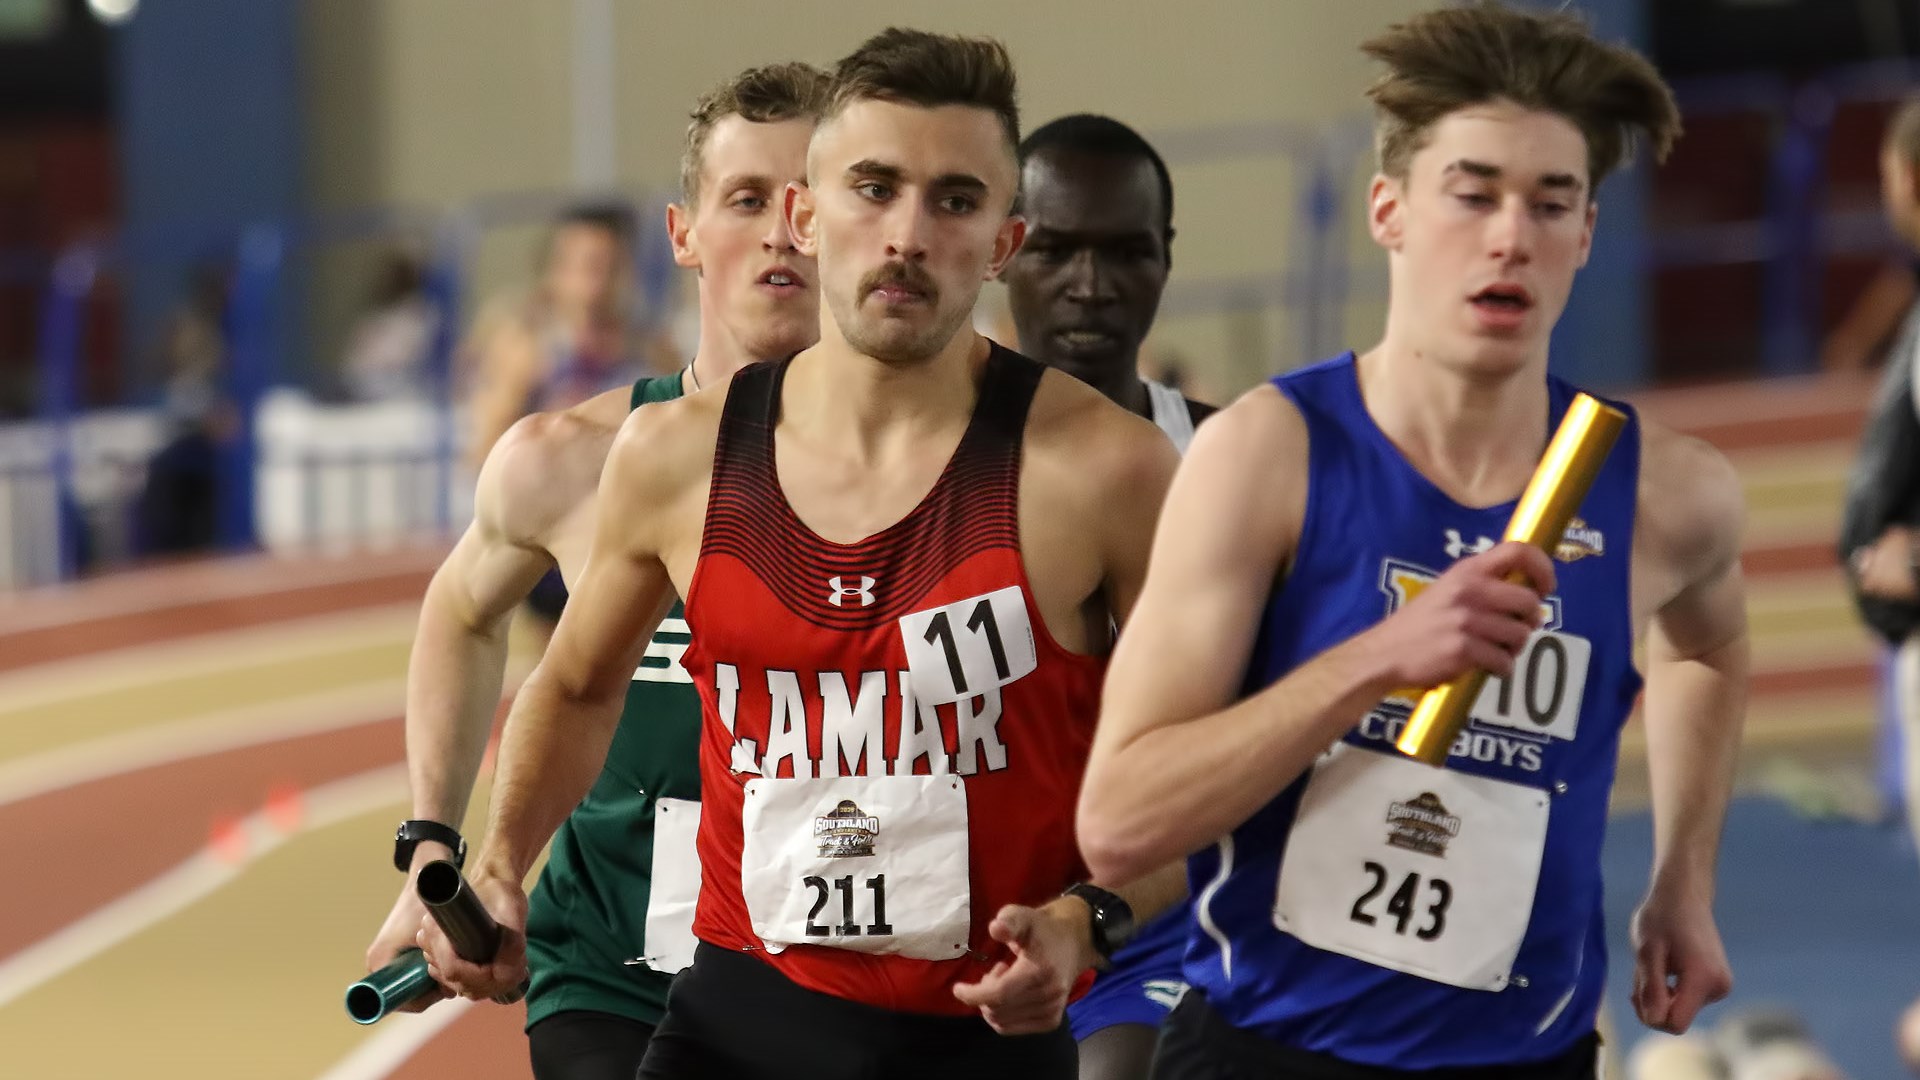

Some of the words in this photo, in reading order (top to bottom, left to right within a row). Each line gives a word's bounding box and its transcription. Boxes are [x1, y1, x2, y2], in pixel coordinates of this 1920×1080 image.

[923, 598, 1011, 695] 11
[714, 662, 1009, 780] LAMAR
[1359, 712, 1543, 772] COBOYS
[815, 817, 879, 836] SOUTHLAND
[803, 873, 894, 937] 211
[1349, 860, 1453, 940] 243
